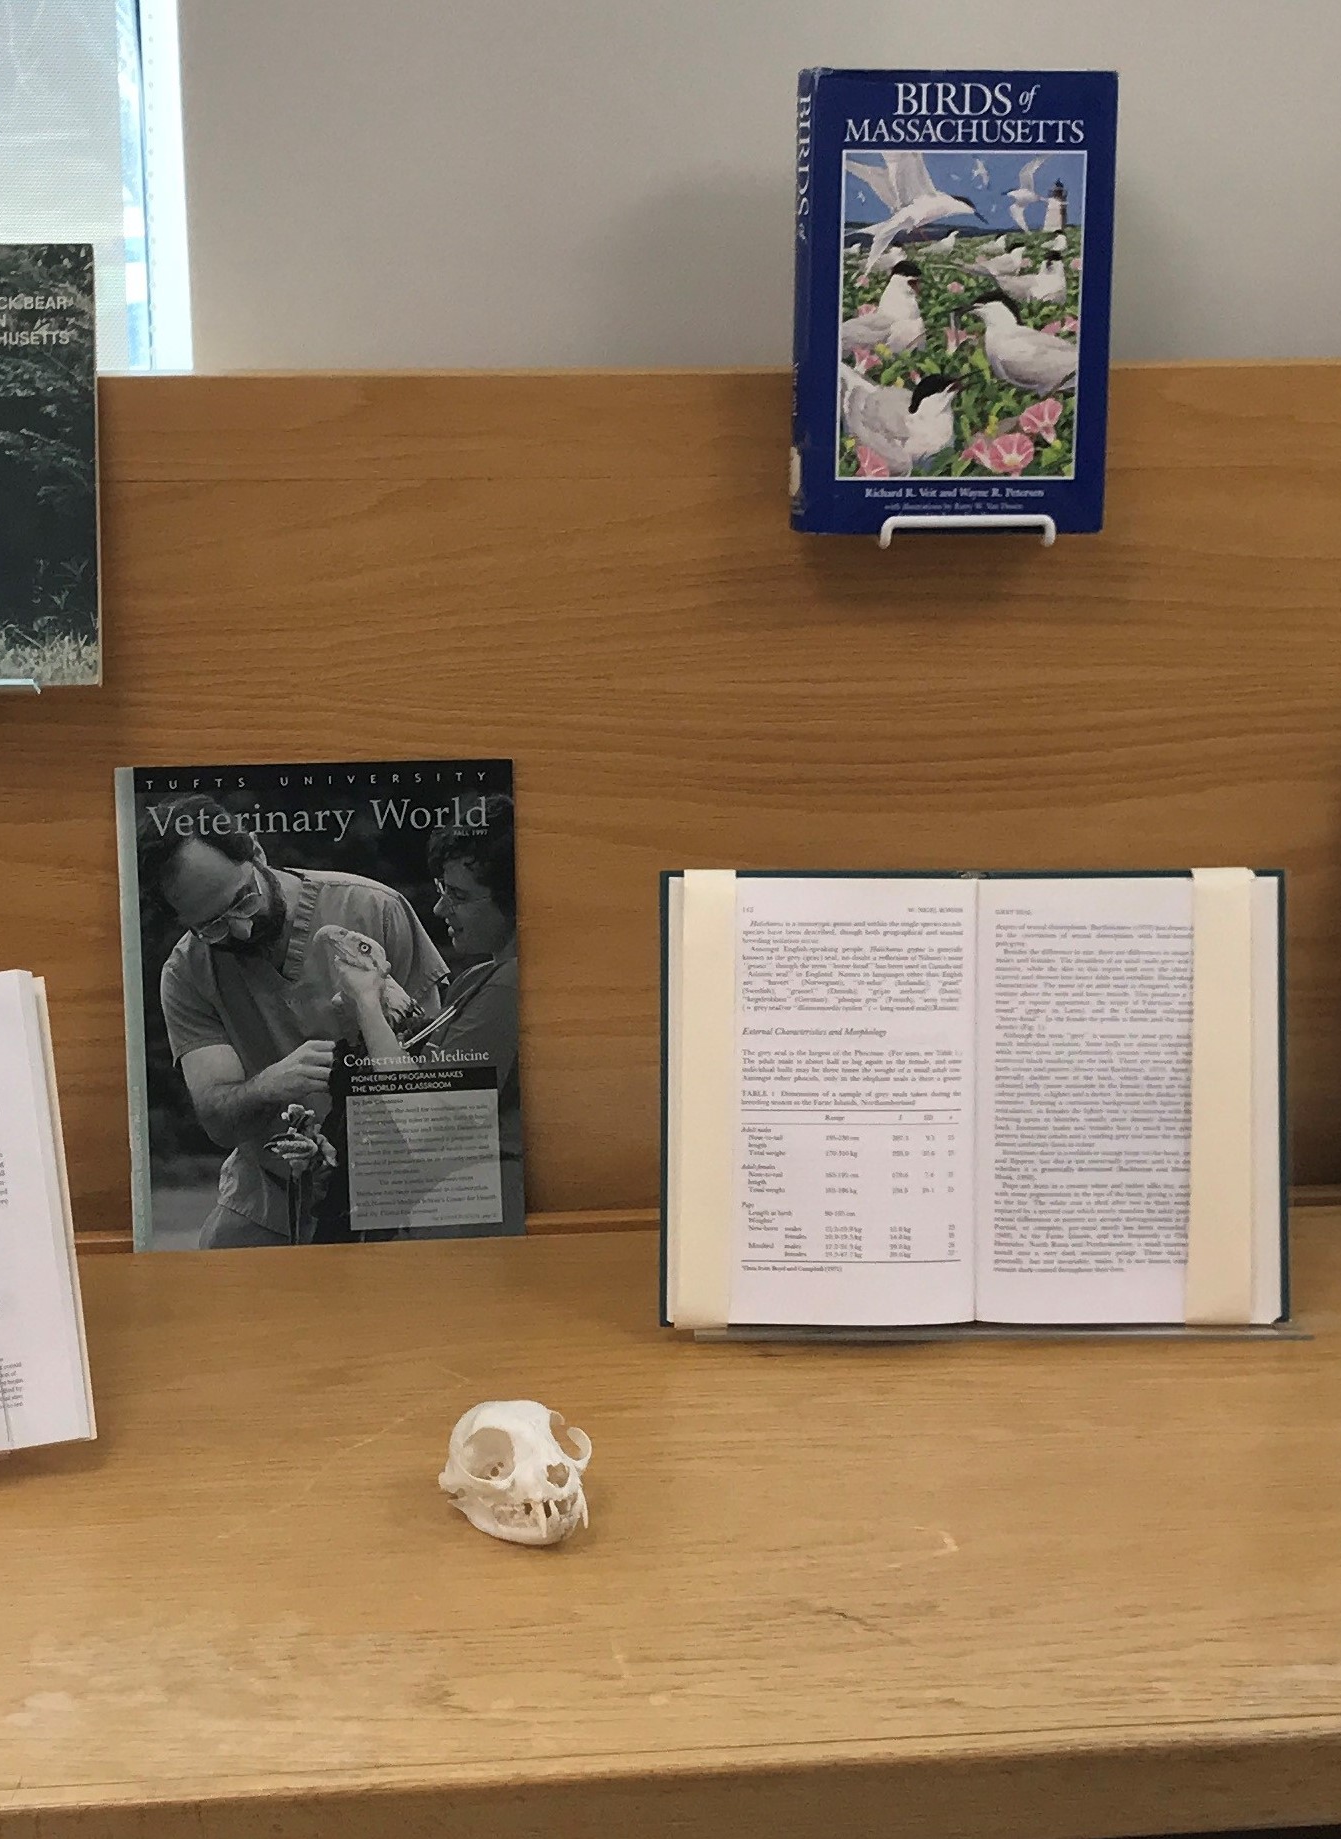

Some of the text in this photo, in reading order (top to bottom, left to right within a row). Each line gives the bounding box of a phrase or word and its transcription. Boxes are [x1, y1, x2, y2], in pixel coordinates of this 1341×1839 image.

[893, 83, 1041, 117] BIRDS of
[844, 119, 1085, 144] MASSACHUSETTS
[22, 296, 67, 310] BEAR
[864, 488, 903, 499] Richard
[939, 488, 956, 498] and
[959, 488, 988, 501] Wayne
[1005, 488, 1044, 499] Petersen
[146, 771, 486, 790] TUFTS UNIVERSITY
[146, 796, 490, 842] Veterinary World
[742, 1027, 887, 1038] External Characteristics and Morphology
[344, 1049, 489, 1068] Conservation Medicine
[351, 1070, 463, 1083] PIONEERING PROGRAM MAKES
[352, 1082, 452, 1093] THE WORLD A CLASSROOM
